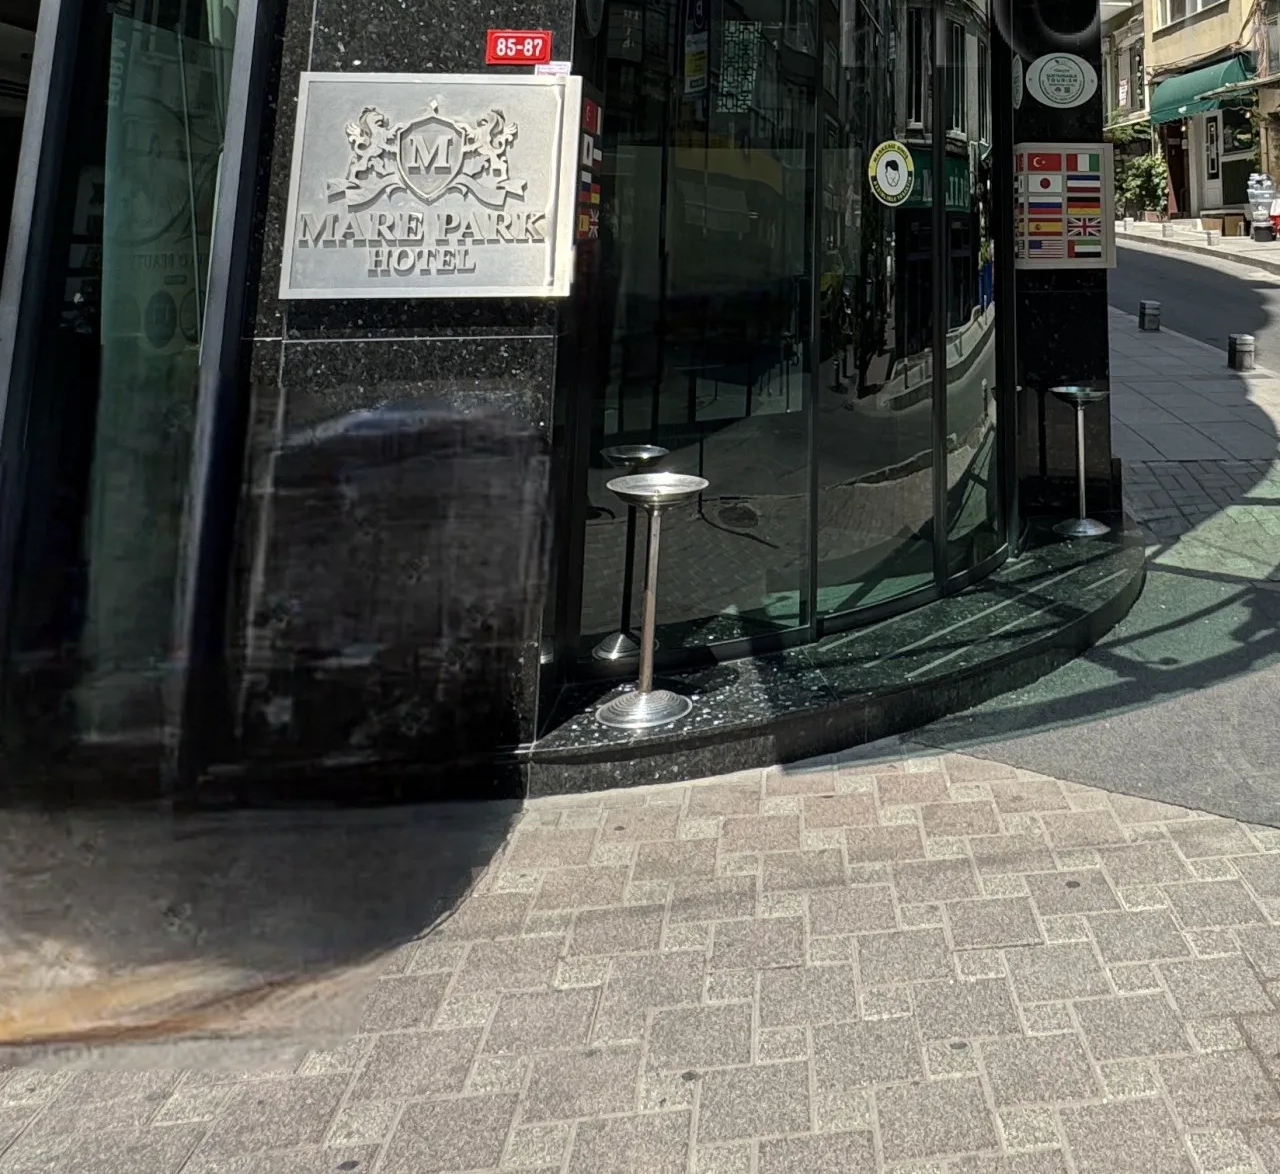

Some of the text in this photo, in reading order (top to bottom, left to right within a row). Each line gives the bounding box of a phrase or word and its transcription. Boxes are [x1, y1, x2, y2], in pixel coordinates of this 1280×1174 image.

[496, 38, 543, 57] 85-87
[407, 134, 453, 174] M
[298, 212, 547, 248] MARE PARK
[367, 247, 477, 277] HOTEL
